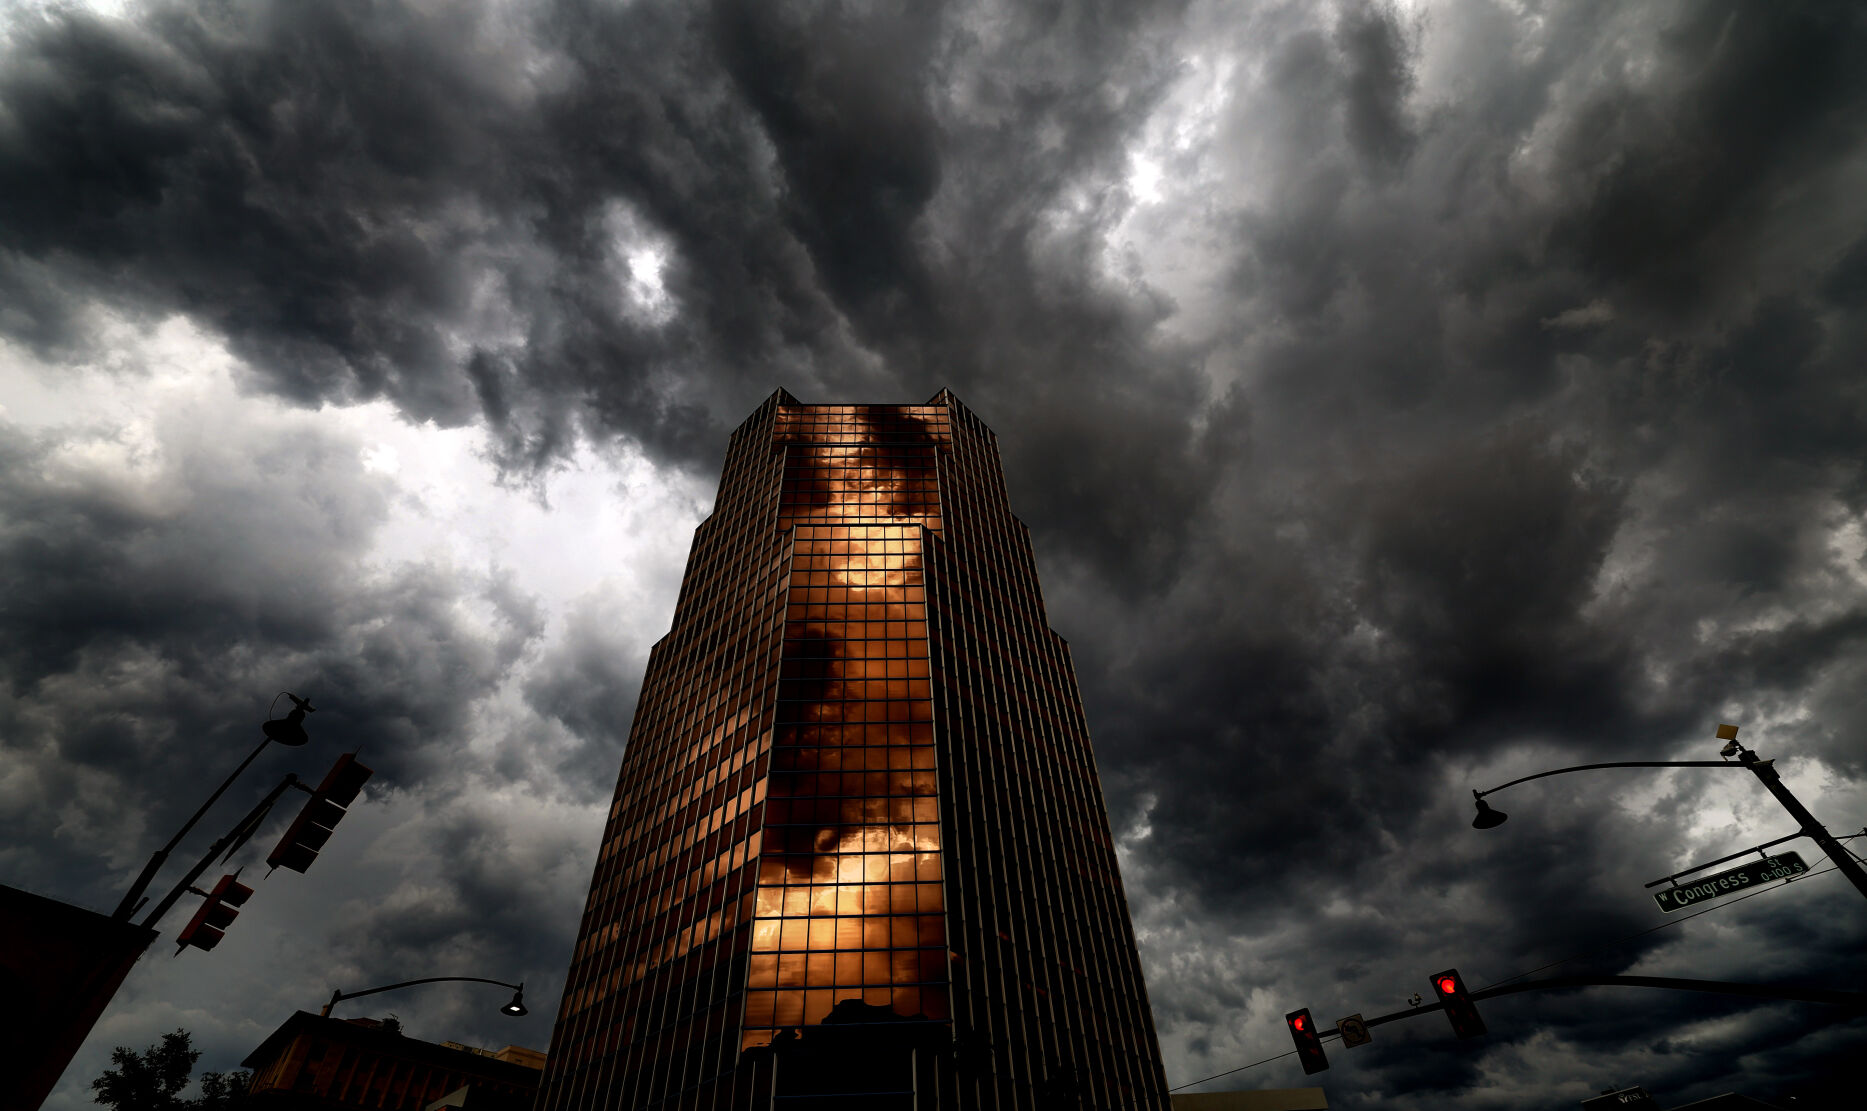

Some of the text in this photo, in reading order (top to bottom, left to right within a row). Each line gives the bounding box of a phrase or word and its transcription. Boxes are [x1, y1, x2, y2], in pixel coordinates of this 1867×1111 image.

[1659, 858, 1781, 905] W Congress St
[1760, 862, 1804, 882] 0-100 S
